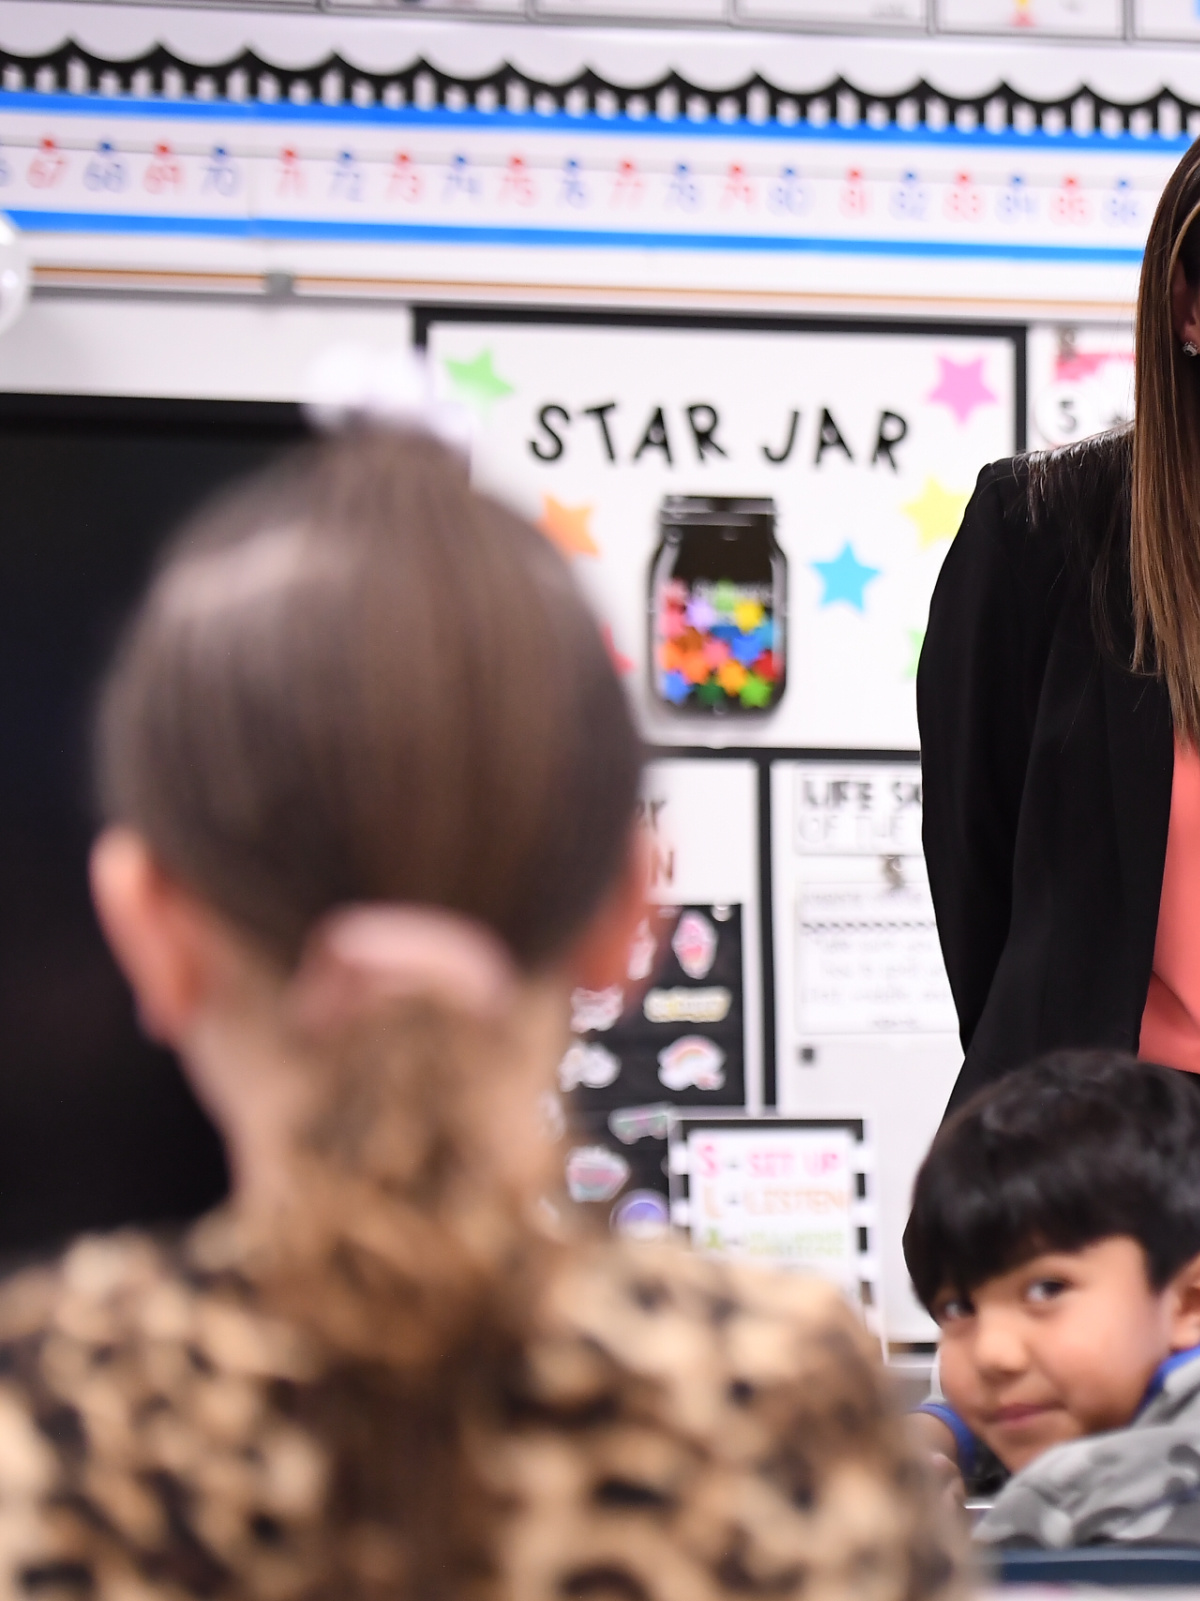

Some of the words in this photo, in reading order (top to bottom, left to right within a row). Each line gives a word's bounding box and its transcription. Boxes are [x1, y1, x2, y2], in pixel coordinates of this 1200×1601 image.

[529, 400, 728, 470] STAR
[762, 407, 910, 474] JAR
[803, 781, 872, 811] LIFE
[747, 1150, 794, 1178] SET
[802, 1151, 841, 1178] UP
[744, 1187, 852, 1216] LISTEN
